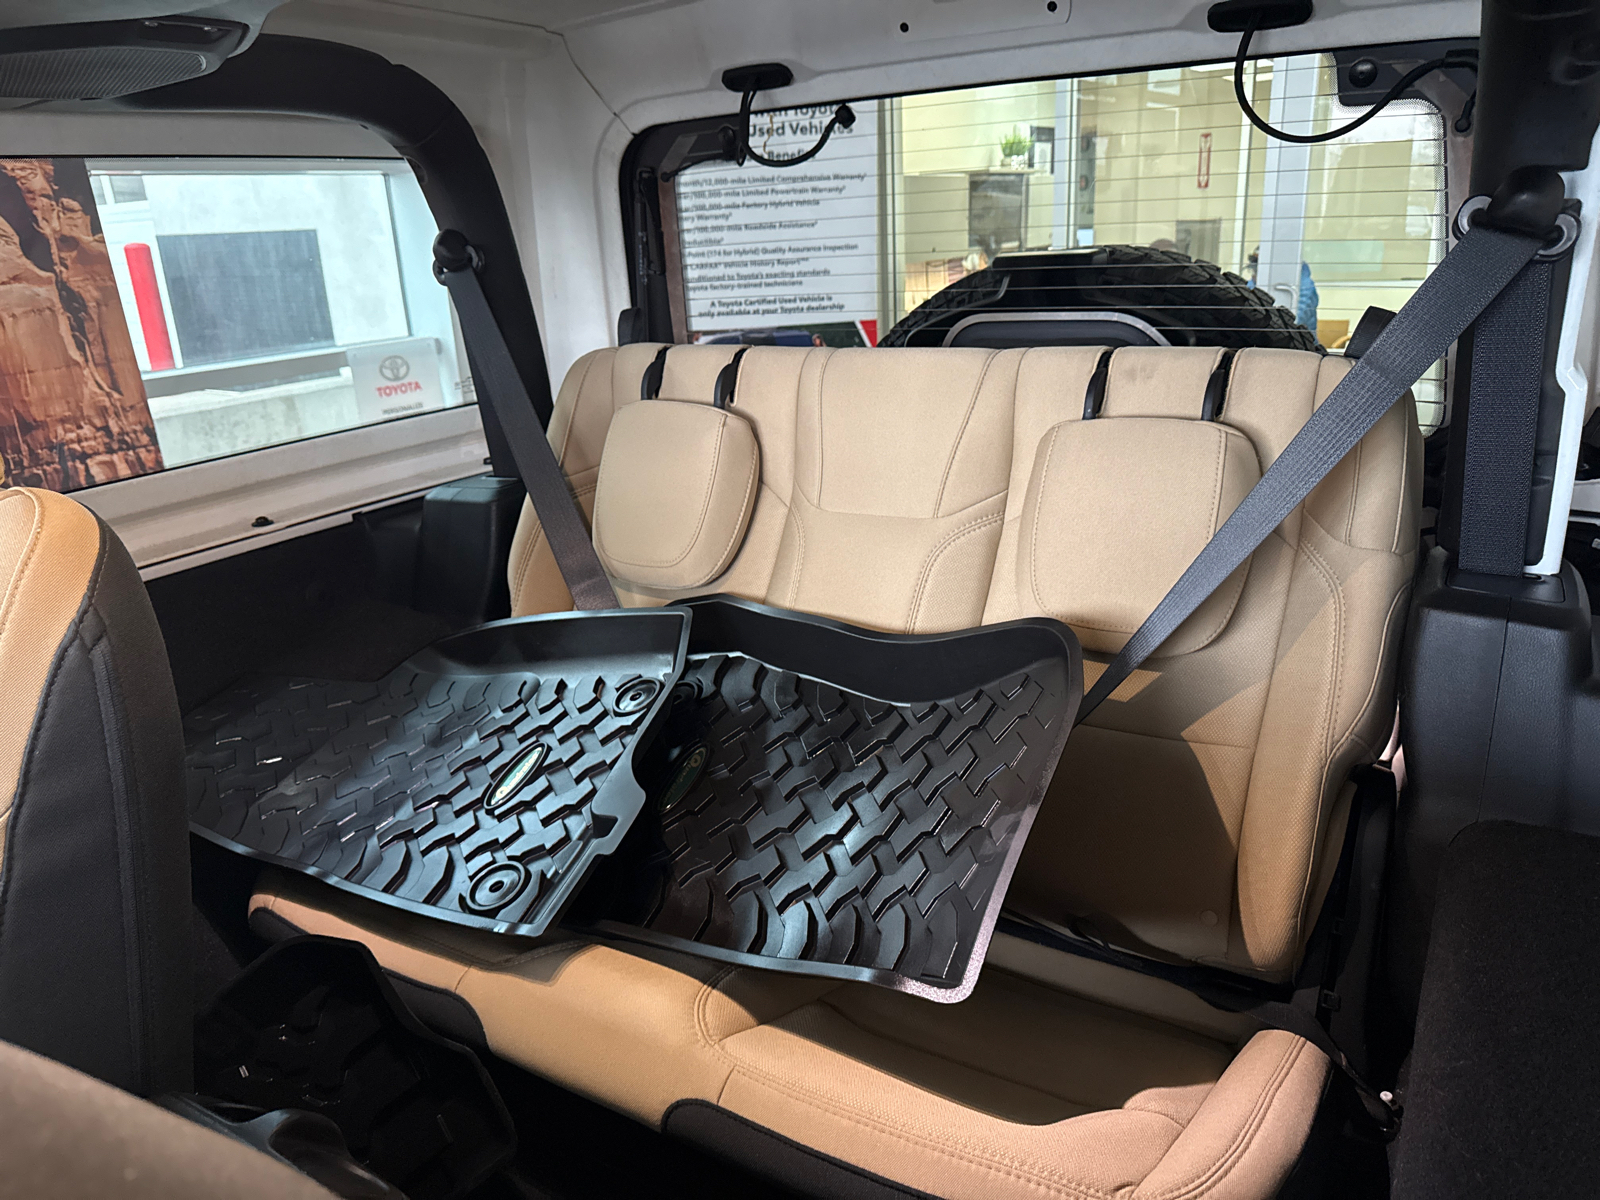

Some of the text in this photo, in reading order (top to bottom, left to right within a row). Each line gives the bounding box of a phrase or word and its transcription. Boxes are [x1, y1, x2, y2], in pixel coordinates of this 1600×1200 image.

[717, 299, 742, 309] Toyota
[743, 296, 777, 306] Certified
[778, 295, 797, 304] Used
[799, 294, 825, 303] Vehicle
[805, 302, 845, 312] dealership
[375, 381, 423, 398] TOYOTA
